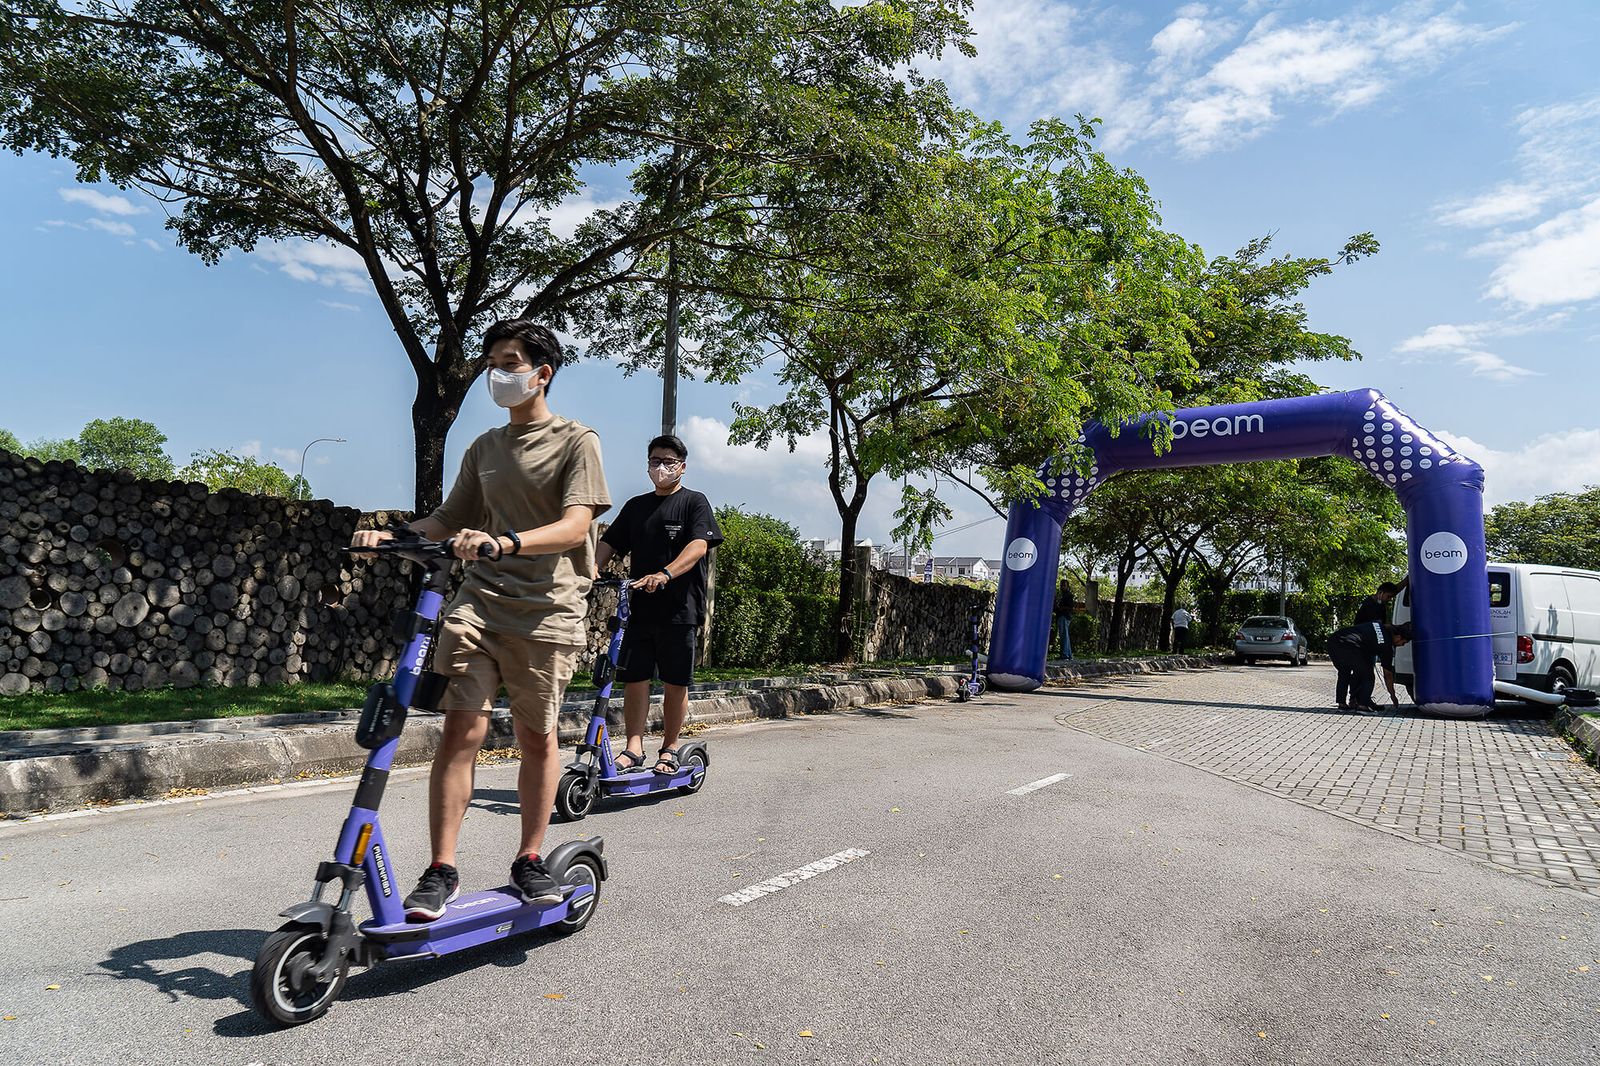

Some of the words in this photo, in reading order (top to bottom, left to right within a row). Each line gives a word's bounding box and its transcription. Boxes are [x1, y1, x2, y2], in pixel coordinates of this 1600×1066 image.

[1170, 414, 1264, 439] beam
[1008, 551, 1034, 559] beam
[1425, 550, 1463, 560] beam
[409, 635, 431, 676] beam
